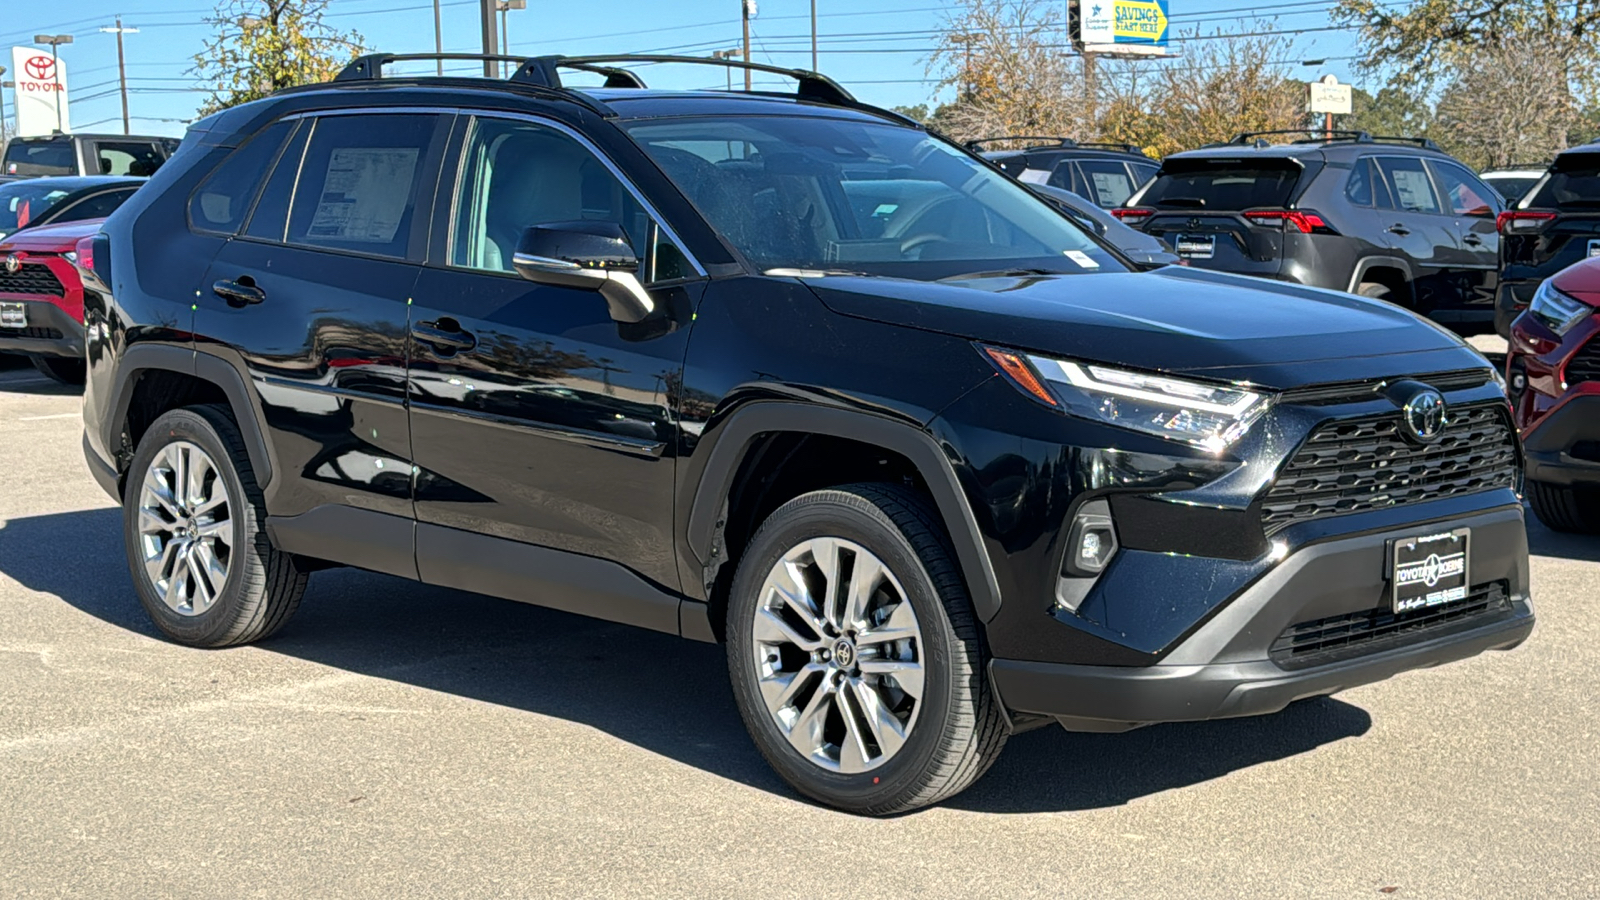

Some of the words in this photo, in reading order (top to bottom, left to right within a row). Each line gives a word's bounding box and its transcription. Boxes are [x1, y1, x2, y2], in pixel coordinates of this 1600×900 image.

[1115, 6, 1158, 22] SAVINGS
[1115, 21, 1138, 31] START
[1140, 23, 1158, 33] HERE
[20, 81, 64, 92] TOYOTA
[1396, 566, 1428, 582] TOYOTA
